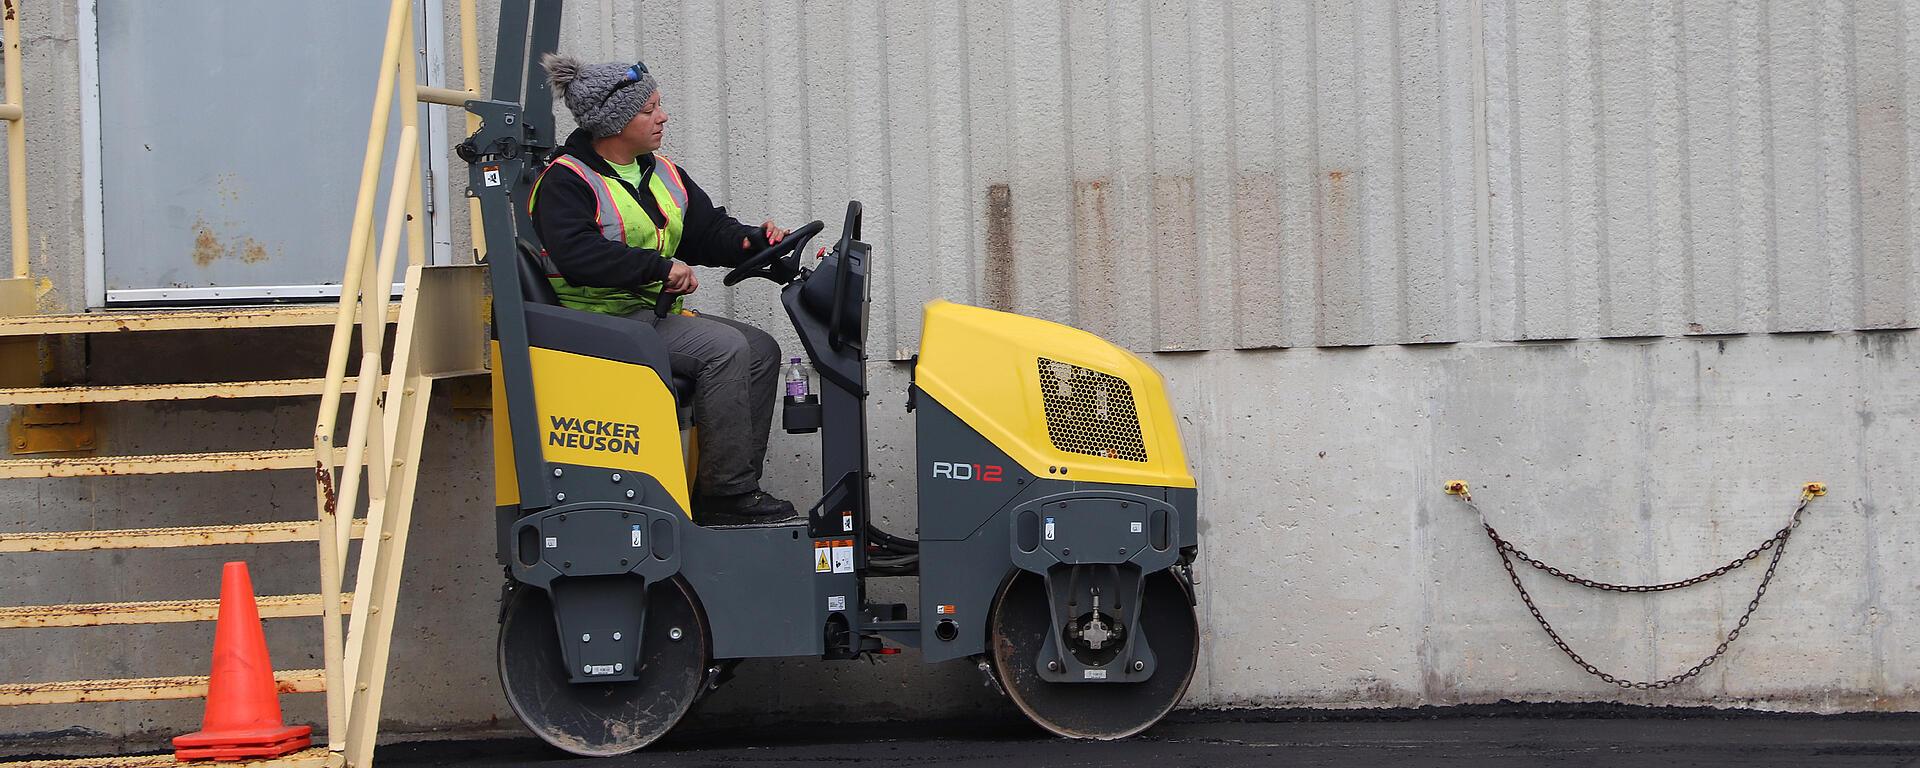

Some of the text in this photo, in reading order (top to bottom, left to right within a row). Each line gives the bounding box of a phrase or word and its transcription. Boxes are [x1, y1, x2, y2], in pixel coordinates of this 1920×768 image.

[550, 415, 640, 439] WACKER
[549, 431, 640, 455] NEUSON
[932, 461, 1003, 482] RD12
